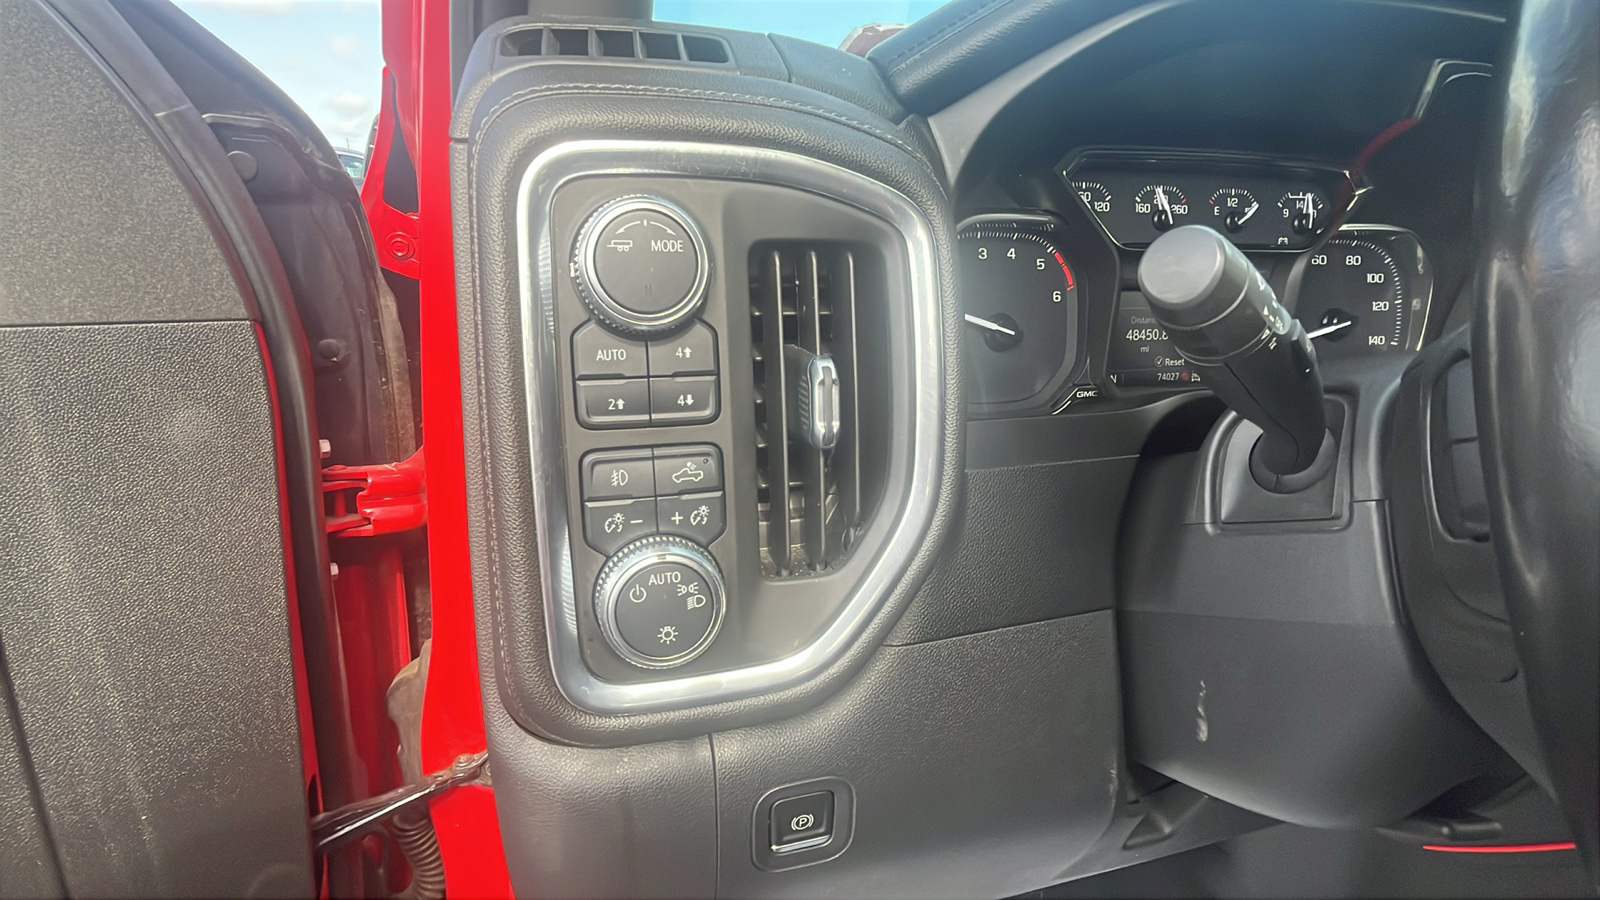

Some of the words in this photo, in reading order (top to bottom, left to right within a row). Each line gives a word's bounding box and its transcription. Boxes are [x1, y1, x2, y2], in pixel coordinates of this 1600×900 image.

[1094, 202, 1111, 212] 120
[1135, 203, 1151, 213] 160
[1296, 200, 1304, 209] 14
[1213, 206, 1220, 215] E
[1282, 208, 1289, 218] 9
[651, 239, 684, 252] MODE
[978, 248, 988, 260] 3
[1006, 248, 1016, 260] 4
[1036, 259, 1046, 270] 5
[1311, 255, 1327, 265] 60
[1345, 255, 1361, 266] 80
[1366, 273, 1384, 283] 100
[1052, 291, 1062, 302] 6
[1372, 301, 1389, 311] 120
[1368, 336, 1386, 345] 140
[675, 349, 684, 359] 4
[1140, 345, 1150, 353] mi
[596, 349, 627, 361] AUTO
[1164, 358, 1185, 366] Reset
[1157, 372, 1180, 381] 74027
[677, 394, 685, 404] 4
[1076, 390, 1098, 398] GMC
[608, 399, 616, 410] 2
[648, 571, 681, 586] AUTO
